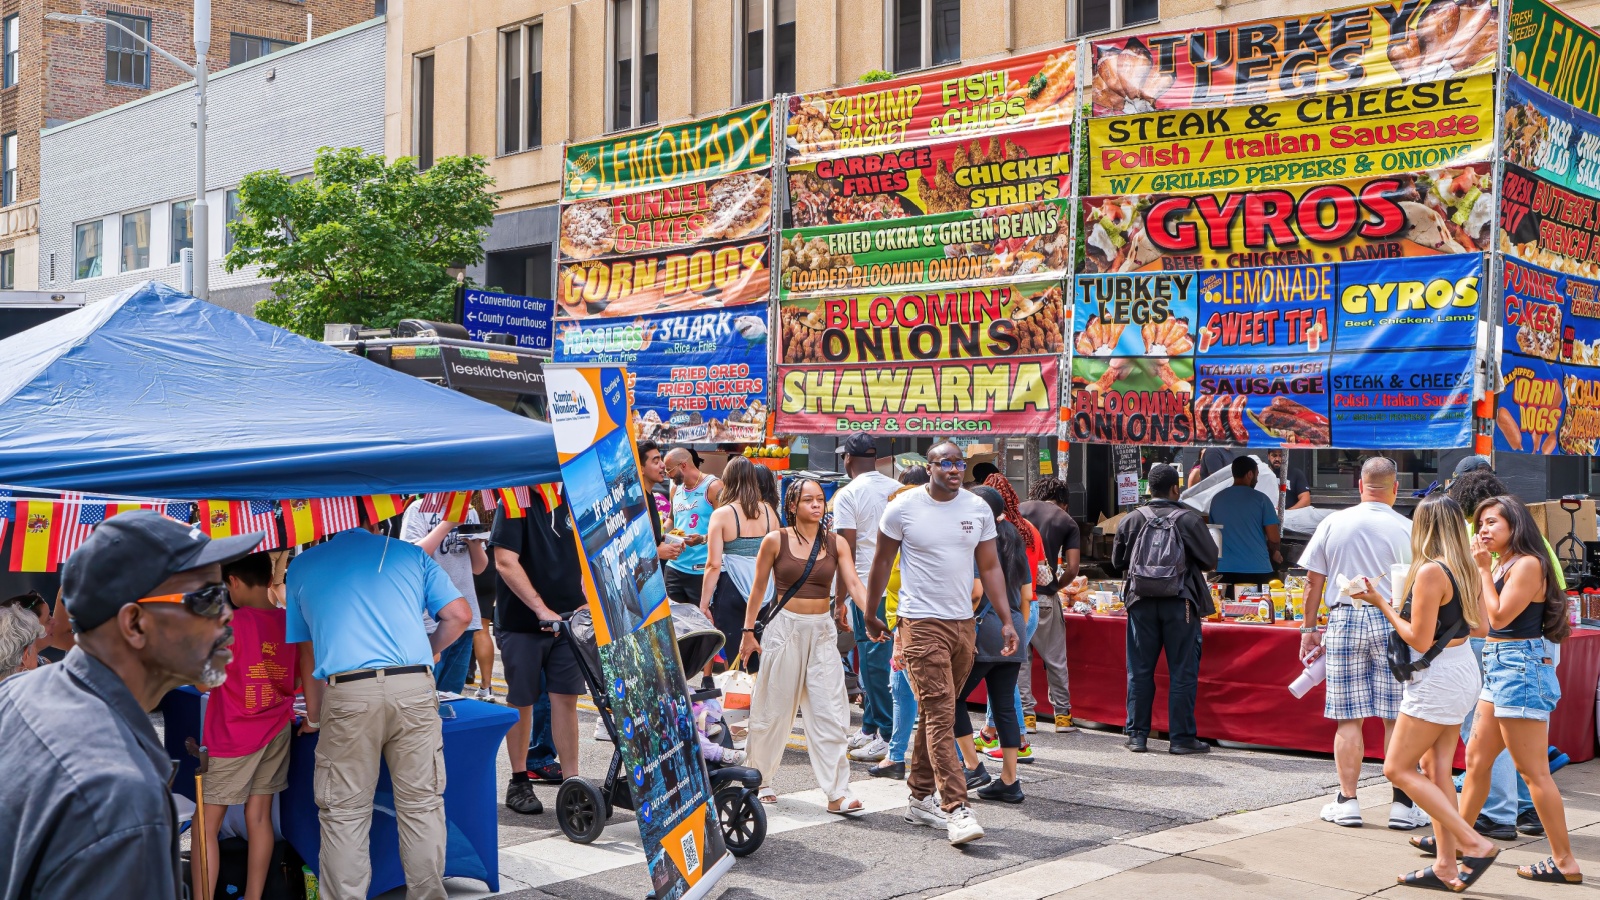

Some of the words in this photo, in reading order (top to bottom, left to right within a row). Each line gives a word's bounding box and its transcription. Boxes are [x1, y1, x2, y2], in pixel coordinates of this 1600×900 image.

[1512, 9, 1534, 27] FRESH
[1147, 2, 1422, 74] TURKEY
[942, 70, 1005, 107] FISH
[1190, 41, 1371, 106] LEGS
[829, 84, 923, 130] SHRIMP
[1108, 107, 1231, 143] STEAK
[1244, 103, 1282, 131] &
[1296, 77, 1469, 124] CHEESE
[840, 118, 911, 150] BASKET
[1101, 142, 1190, 171] Polish
[1199, 138, 1214, 164] /
[1225, 126, 1321, 161] Italian
[1329, 114, 1480, 149] Sausage
[1548, 115, 1572, 149] TACO
[598, 109, 768, 194] LEMONADE
[815, 147, 933, 181] GARBAGE
[1150, 166, 1239, 192] GRILLED
[1246, 156, 1347, 184] PEPPERS
[1354, 154, 1373, 174] &
[1380, 143, 1472, 171] ONIONS
[1534, 144, 1570, 176] SALAD
[842, 169, 909, 198] FRIES
[953, 152, 1072, 189] CHICKEN
[611, 183, 713, 224] FUNNEL
[969, 178, 1060, 209] STRIPS
[1143, 177, 1409, 252] GYROS
[614, 214, 707, 253] CAKES
[828, 230, 872, 256] FRIED
[874, 226, 919, 251] OKRA
[922, 223, 937, 247] &
[938, 217, 995, 246] GREEN
[997, 209, 1058, 240] BEANS
[1538, 218, 1590, 260] FRENCH
[1161, 253, 1203, 272] BEEF
[1226, 248, 1313, 270] CHICKEN
[1339, 242, 1404, 262] LAMB
[564, 258, 658, 306] CORN
[663, 243, 768, 297] DOGS
[790, 265, 851, 293] LOADED
[853, 258, 925, 288] BLOOMIN
[928, 254, 983, 282] ONION
[1078, 274, 1194, 303] TURKEY
[1222, 266, 1332, 305] LEMONADE
[1504, 260, 1565, 304] FUNNEL
[479, 294, 521, 309] Convention
[523, 300, 546, 311] Center
[824, 286, 1012, 330] BLOOMIN'
[1098, 297, 1169, 325] LEGS
[1341, 276, 1479, 314] GYROS
[478, 312, 504, 327] County
[506, 315, 547, 329] Courthouse
[659, 313, 733, 342] SHARK
[1206, 310, 1279, 346] SWEET
[1284, 308, 1329, 344] TEA
[1344, 319, 1376, 327] Beef,
[1379, 316, 1434, 325] Chicken,
[1437, 314, 1475, 322] Lamb
[1505, 294, 1557, 334] CAKES
[520, 335, 535, 346] Arts
[536, 336, 546, 347] Ctr
[674, 342, 691, 353] Rice
[698, 340, 717, 351] Fries
[821, 317, 1021, 363] ONIONS
[620, 351, 637, 363] Fries
[670, 366, 706, 381] FRIED
[709, 363, 749, 379] OREO
[1199, 363, 1254, 376] ITALIAN
[1256, 363, 1267, 374] &
[1270, 362, 1323, 374] POLISH
[657, 383, 694, 397] FRIED
[695, 379, 763, 395] SNICKERS
[780, 361, 1051, 414] SHAWARMA
[1199, 376, 1325, 396] SAUSAGE
[1333, 374, 1384, 389] STEAK
[1389, 374, 1404, 388] &
[553, 403, 578, 415] Wonders
[669, 396, 707, 411] FRIED
[709, 394, 749, 410] TWIX
[1076, 390, 1191, 417] BLOOMIN'
[1334, 393, 1369, 407] Polish
[1382, 392, 1419, 407] Italian
[836, 417, 880, 432] Beef
[883, 418, 900, 431] &
[905, 417, 992, 432] Chicken
[1073, 411, 1192, 443] ONIONS
[593, 499, 602, 522] If
[601, 494, 613, 518] you
[611, 482, 625, 504] love
[689, 514, 699, 529] 3
[602, 545, 616, 567] The
[613, 527, 635, 557] Camino
[617, 560, 628, 579] for
[627, 550, 639, 576] you
[643, 758, 660, 775] Luggage
